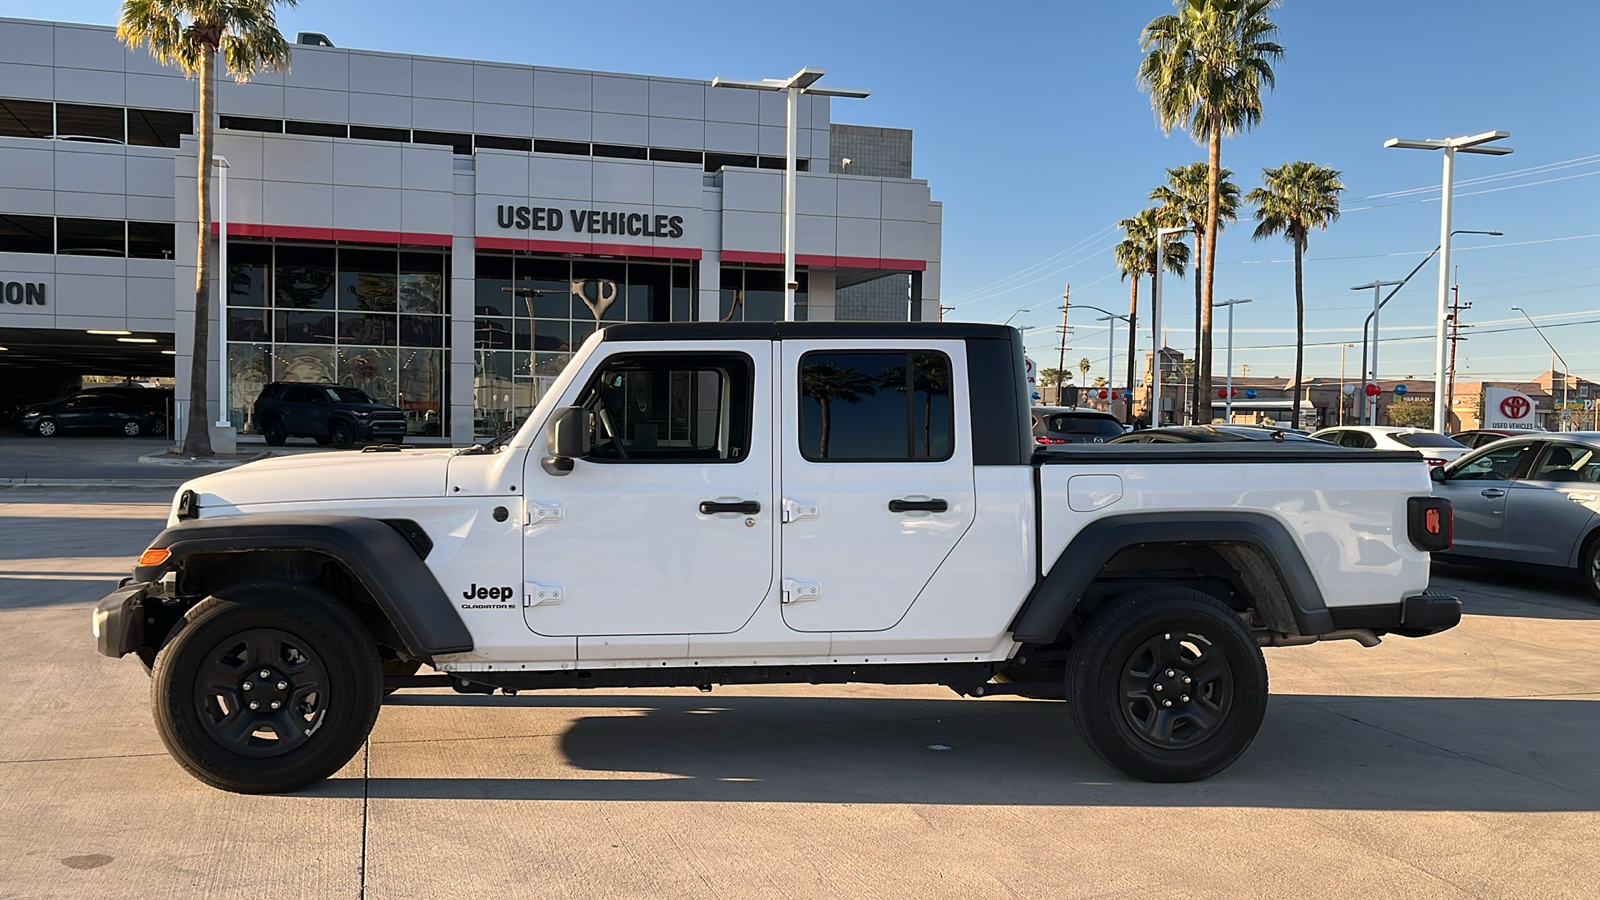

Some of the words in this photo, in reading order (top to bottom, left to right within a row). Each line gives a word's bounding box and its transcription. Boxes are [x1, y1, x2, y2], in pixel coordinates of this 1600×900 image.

[497, 205, 563, 231] USED
[570, 209, 684, 238] VEHICLES
[1509, 422, 1533, 430] VEHICLES
[463, 583, 513, 602] Jeep
